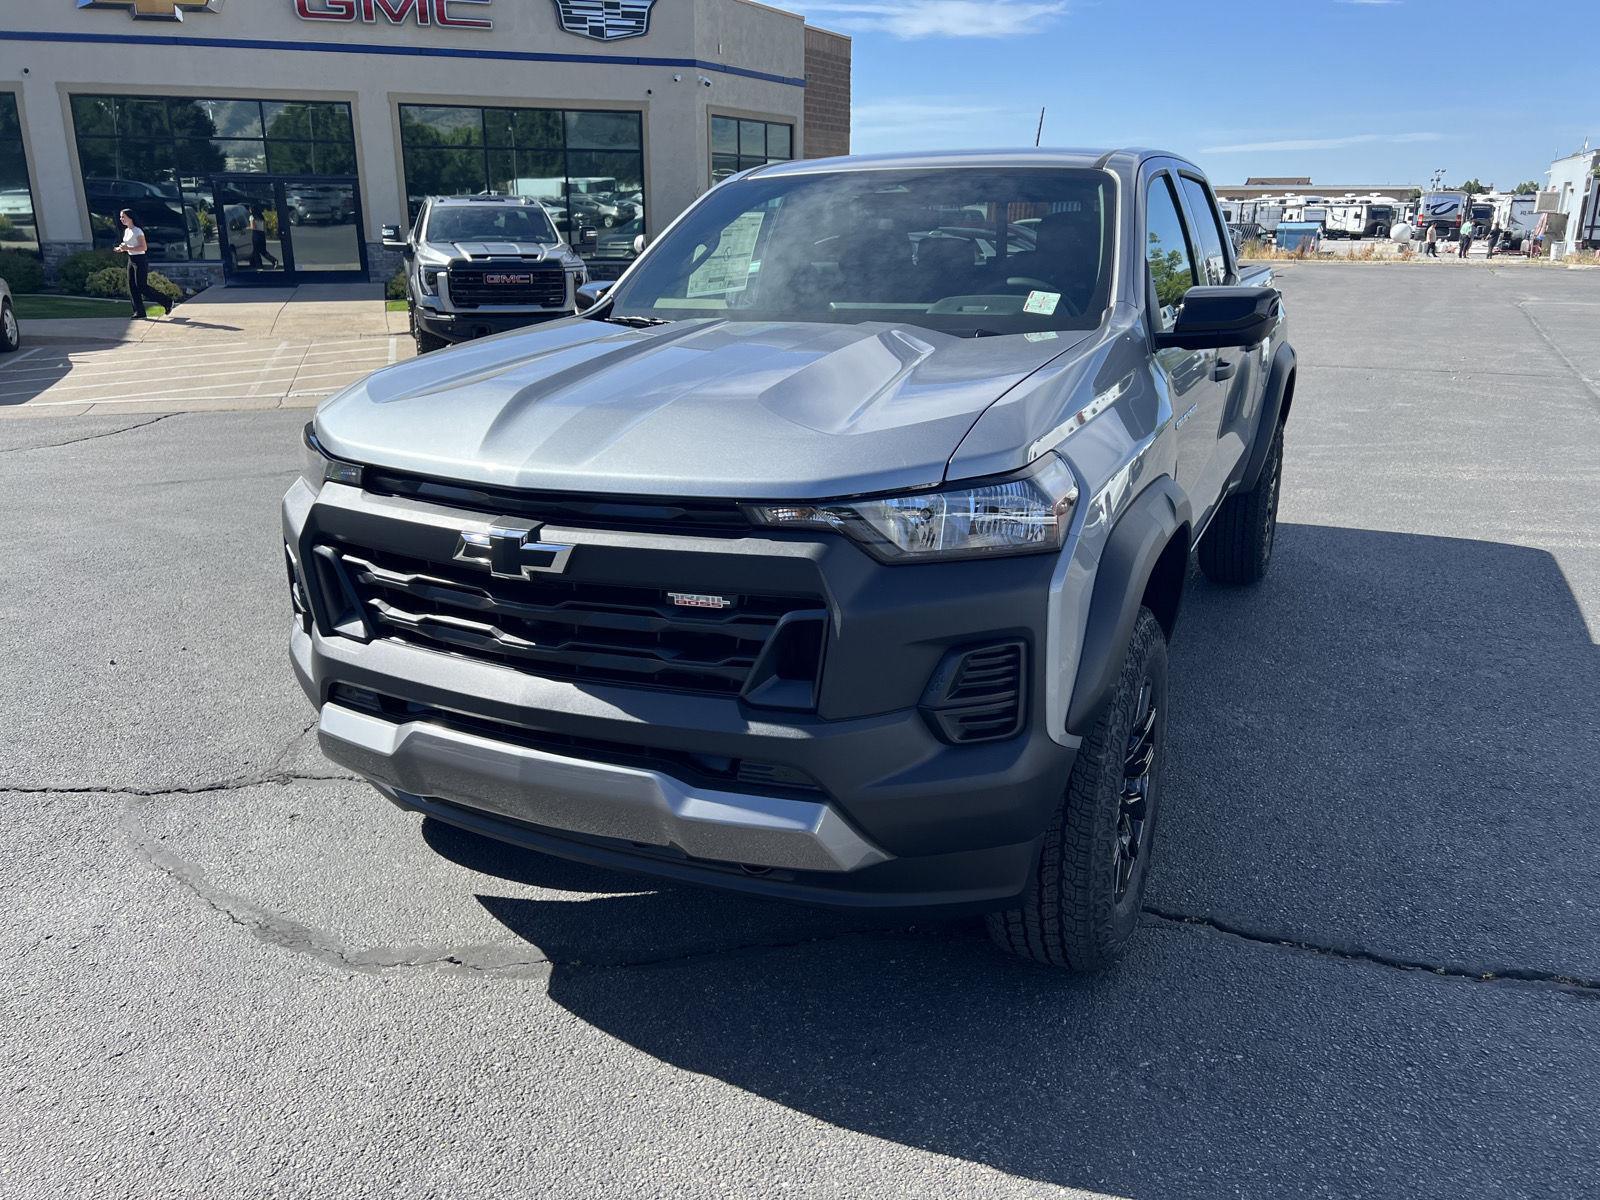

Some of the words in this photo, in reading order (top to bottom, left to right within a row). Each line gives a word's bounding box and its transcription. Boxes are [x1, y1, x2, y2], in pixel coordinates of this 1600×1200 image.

[295, 0, 493, 29] GMC
[486, 274, 530, 284] GMC
[668, 592, 730, 604] TRAIL
[675, 599, 723, 608] BOSS
